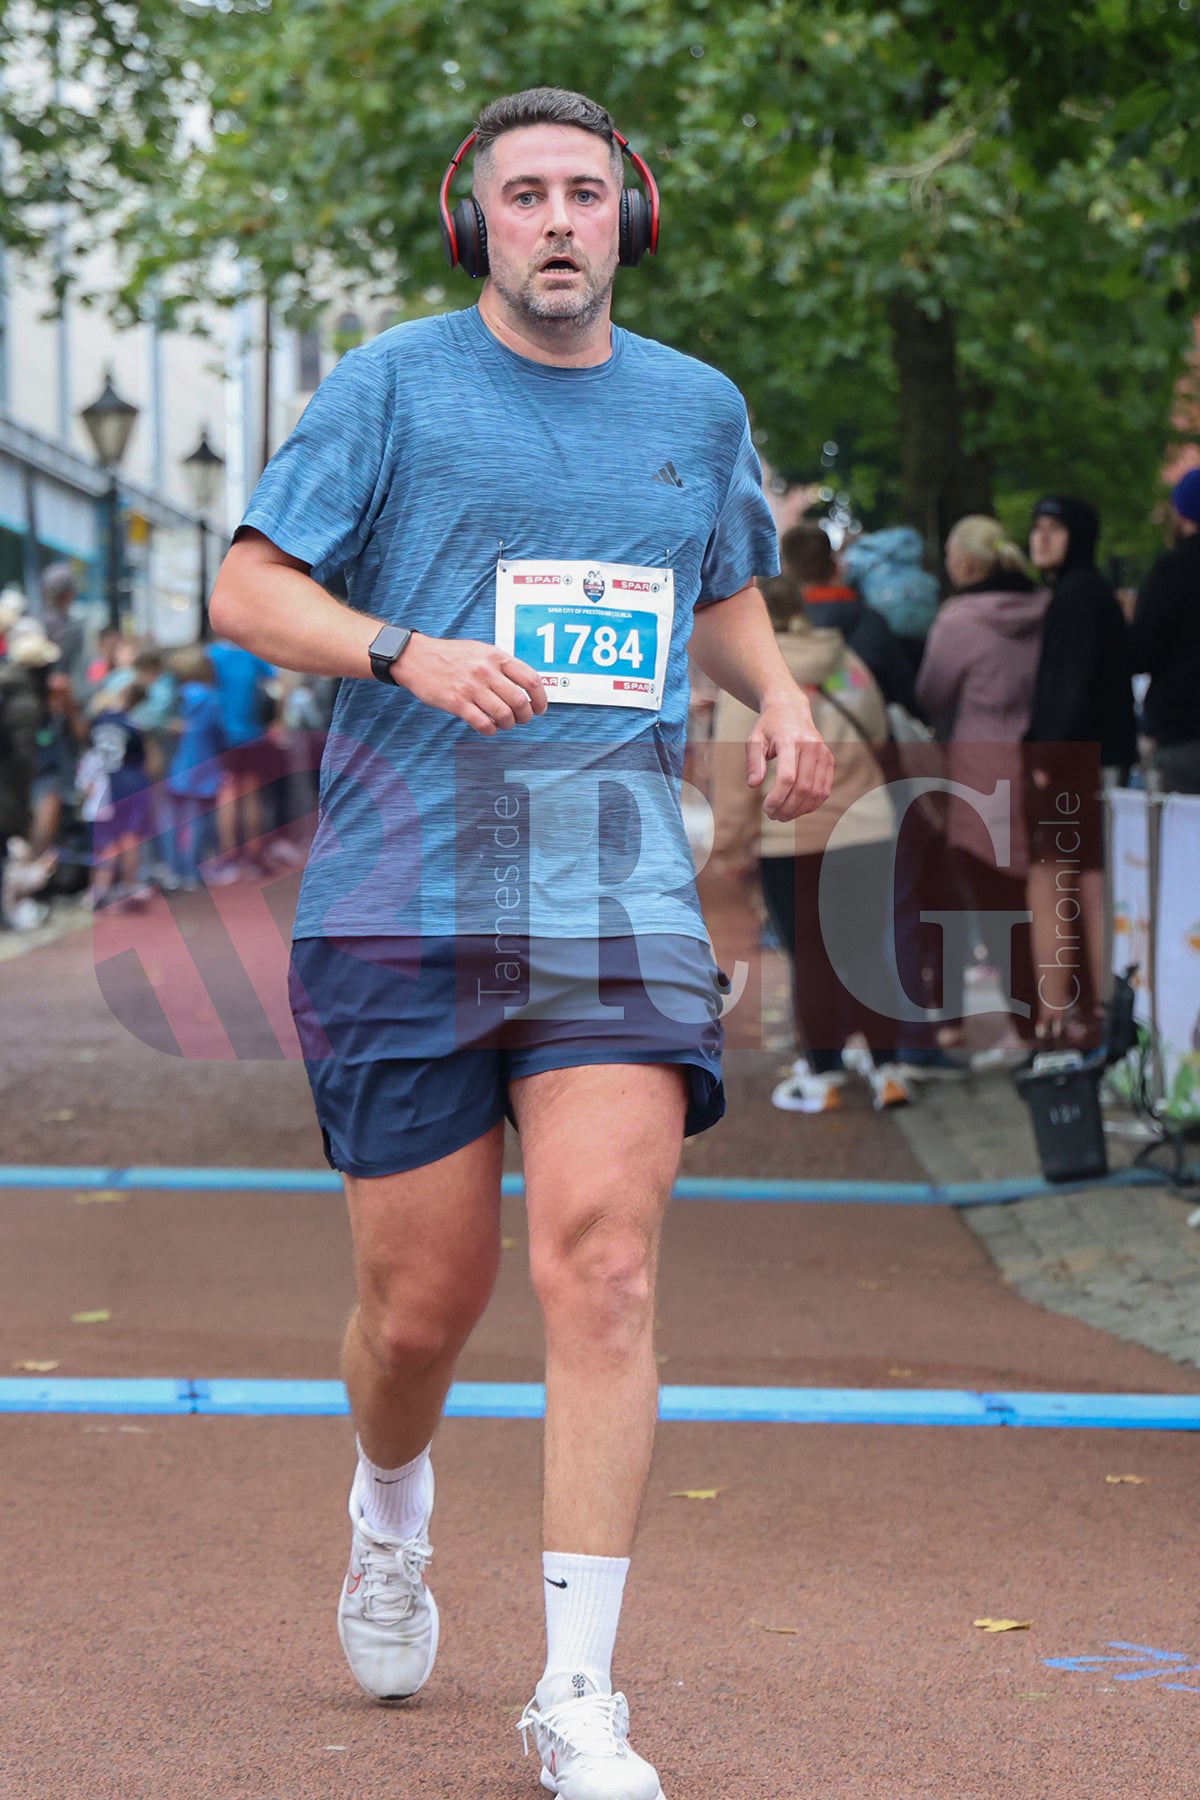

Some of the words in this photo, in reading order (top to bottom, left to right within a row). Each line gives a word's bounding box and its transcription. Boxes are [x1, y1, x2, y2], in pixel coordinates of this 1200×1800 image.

[525, 576, 560, 584] SPAR
[621, 581, 649, 592] SPAR
[536, 623, 643, 668] 1784
[541, 677, 558, 685] AR
[623, 682, 649, 692] SPAR
